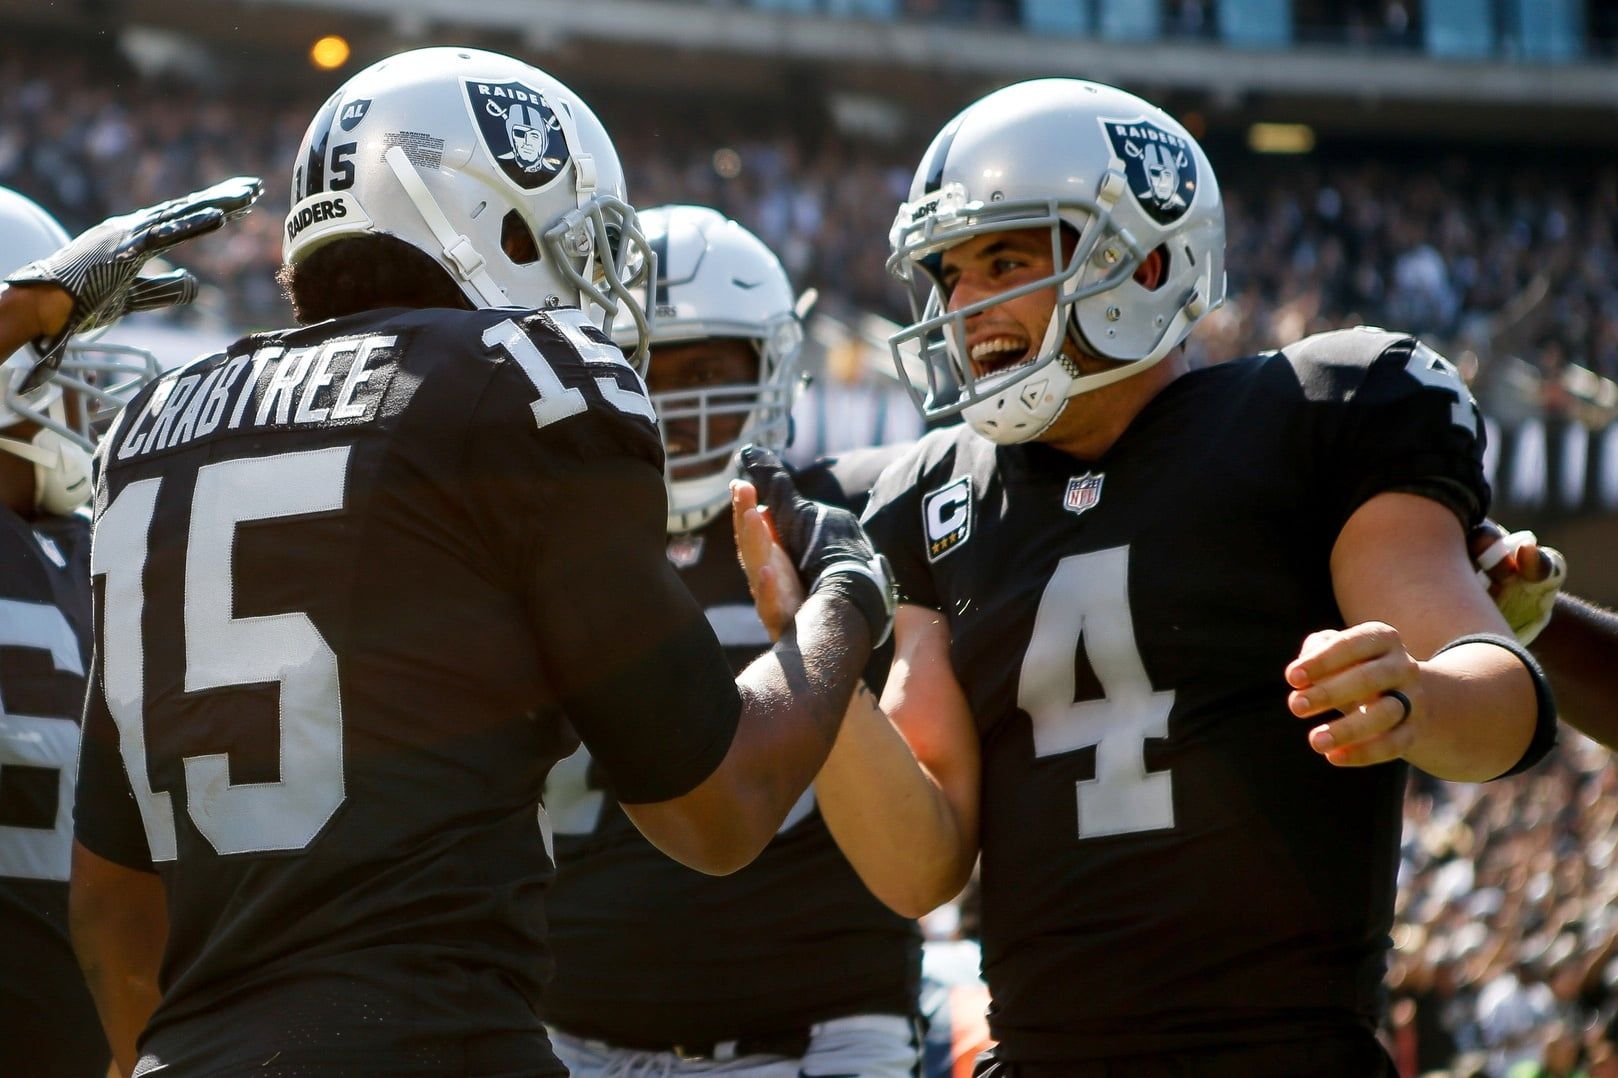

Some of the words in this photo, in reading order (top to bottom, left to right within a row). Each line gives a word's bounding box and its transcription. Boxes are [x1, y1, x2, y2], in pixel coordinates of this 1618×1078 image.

[342, 104, 364, 120] AL
[1115, 125, 1185, 149] RAIDERS
[287, 198, 347, 243] RAIDERS
[117, 335, 398, 461] CRABTREE
[481, 308, 657, 430] 15
[1404, 340, 1478, 440] 4
[927, 483, 968, 541] C
[90, 445, 350, 862] 15
[1016, 544, 1177, 840] 4
